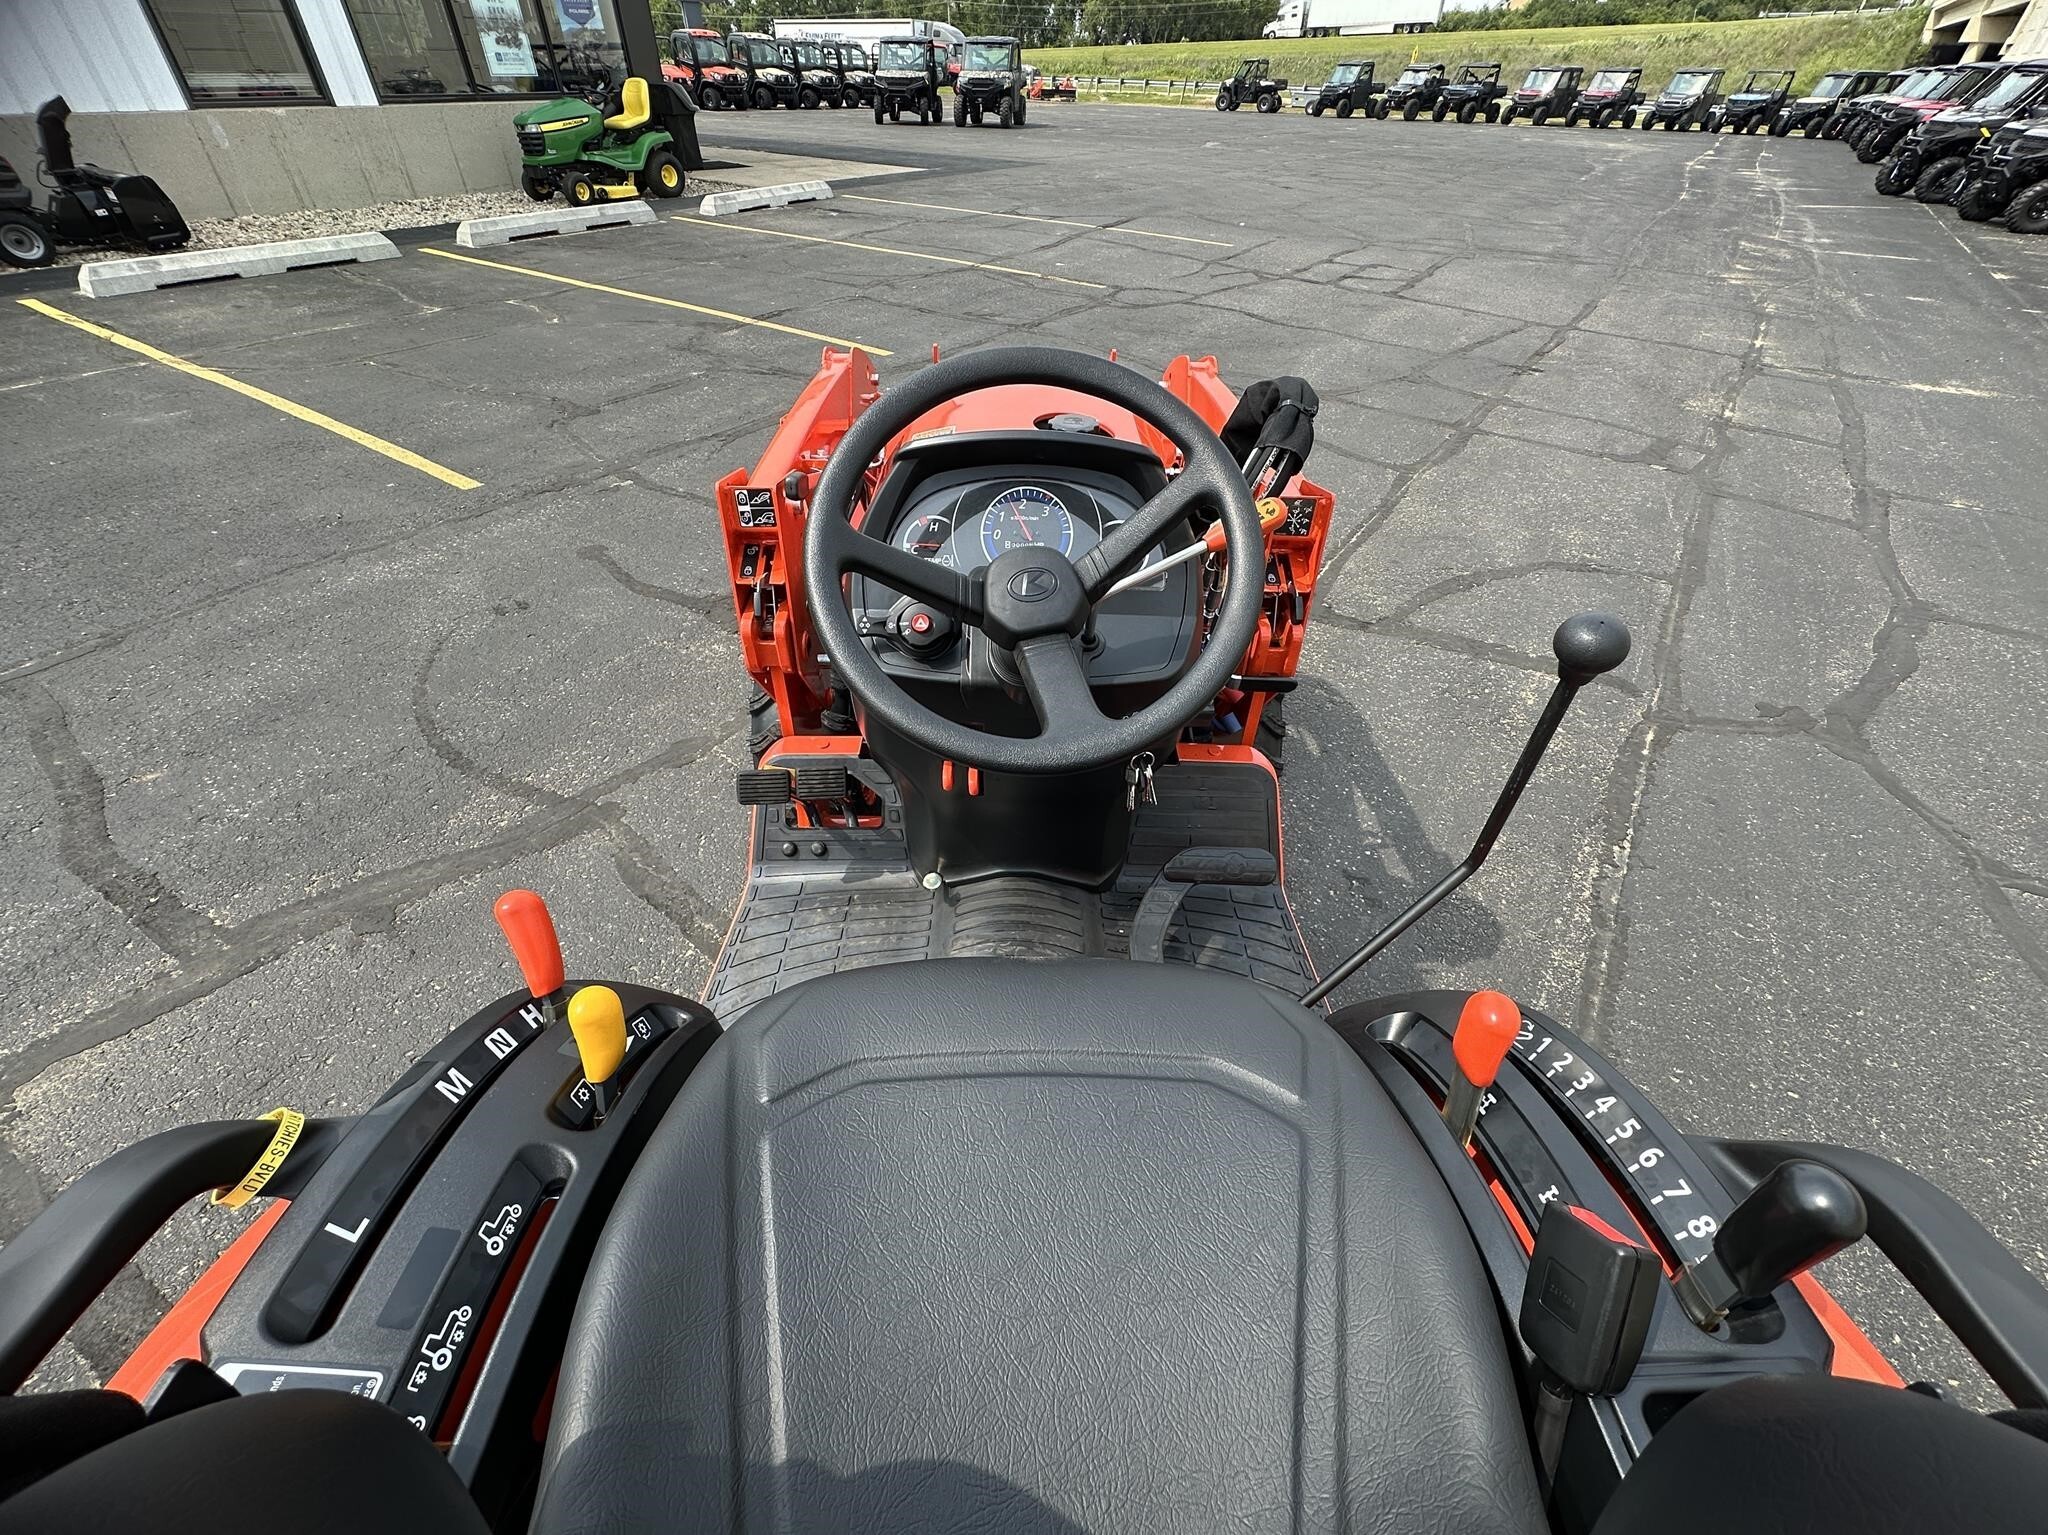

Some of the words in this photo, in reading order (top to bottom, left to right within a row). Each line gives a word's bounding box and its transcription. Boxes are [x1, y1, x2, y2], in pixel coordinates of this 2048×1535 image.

[1018, 498, 1027, 509] 2
[999, 511, 1005, 522] 1
[1041, 506, 1050, 517] 3
[929, 521, 939, 532] H
[993, 529, 1002, 540] 0
[910, 544, 920, 555] C
[518, 1003, 544, 1029] H
[434, 1067, 474, 1104] M
[1536, 1037, 1553, 1053] 1
[1552, 1052, 1574, 1073] 2
[1572, 1071, 1595, 1090] 3
[1594, 1095, 1618, 1115] 4
[1615, 1117, 1642, 1138] 5
[1638, 1147, 1665, 1168] 6
[1662, 1178, 1693, 1198] 7
[1687, 1214, 1718, 1238] 8
[324, 1217, 370, 1243] L
